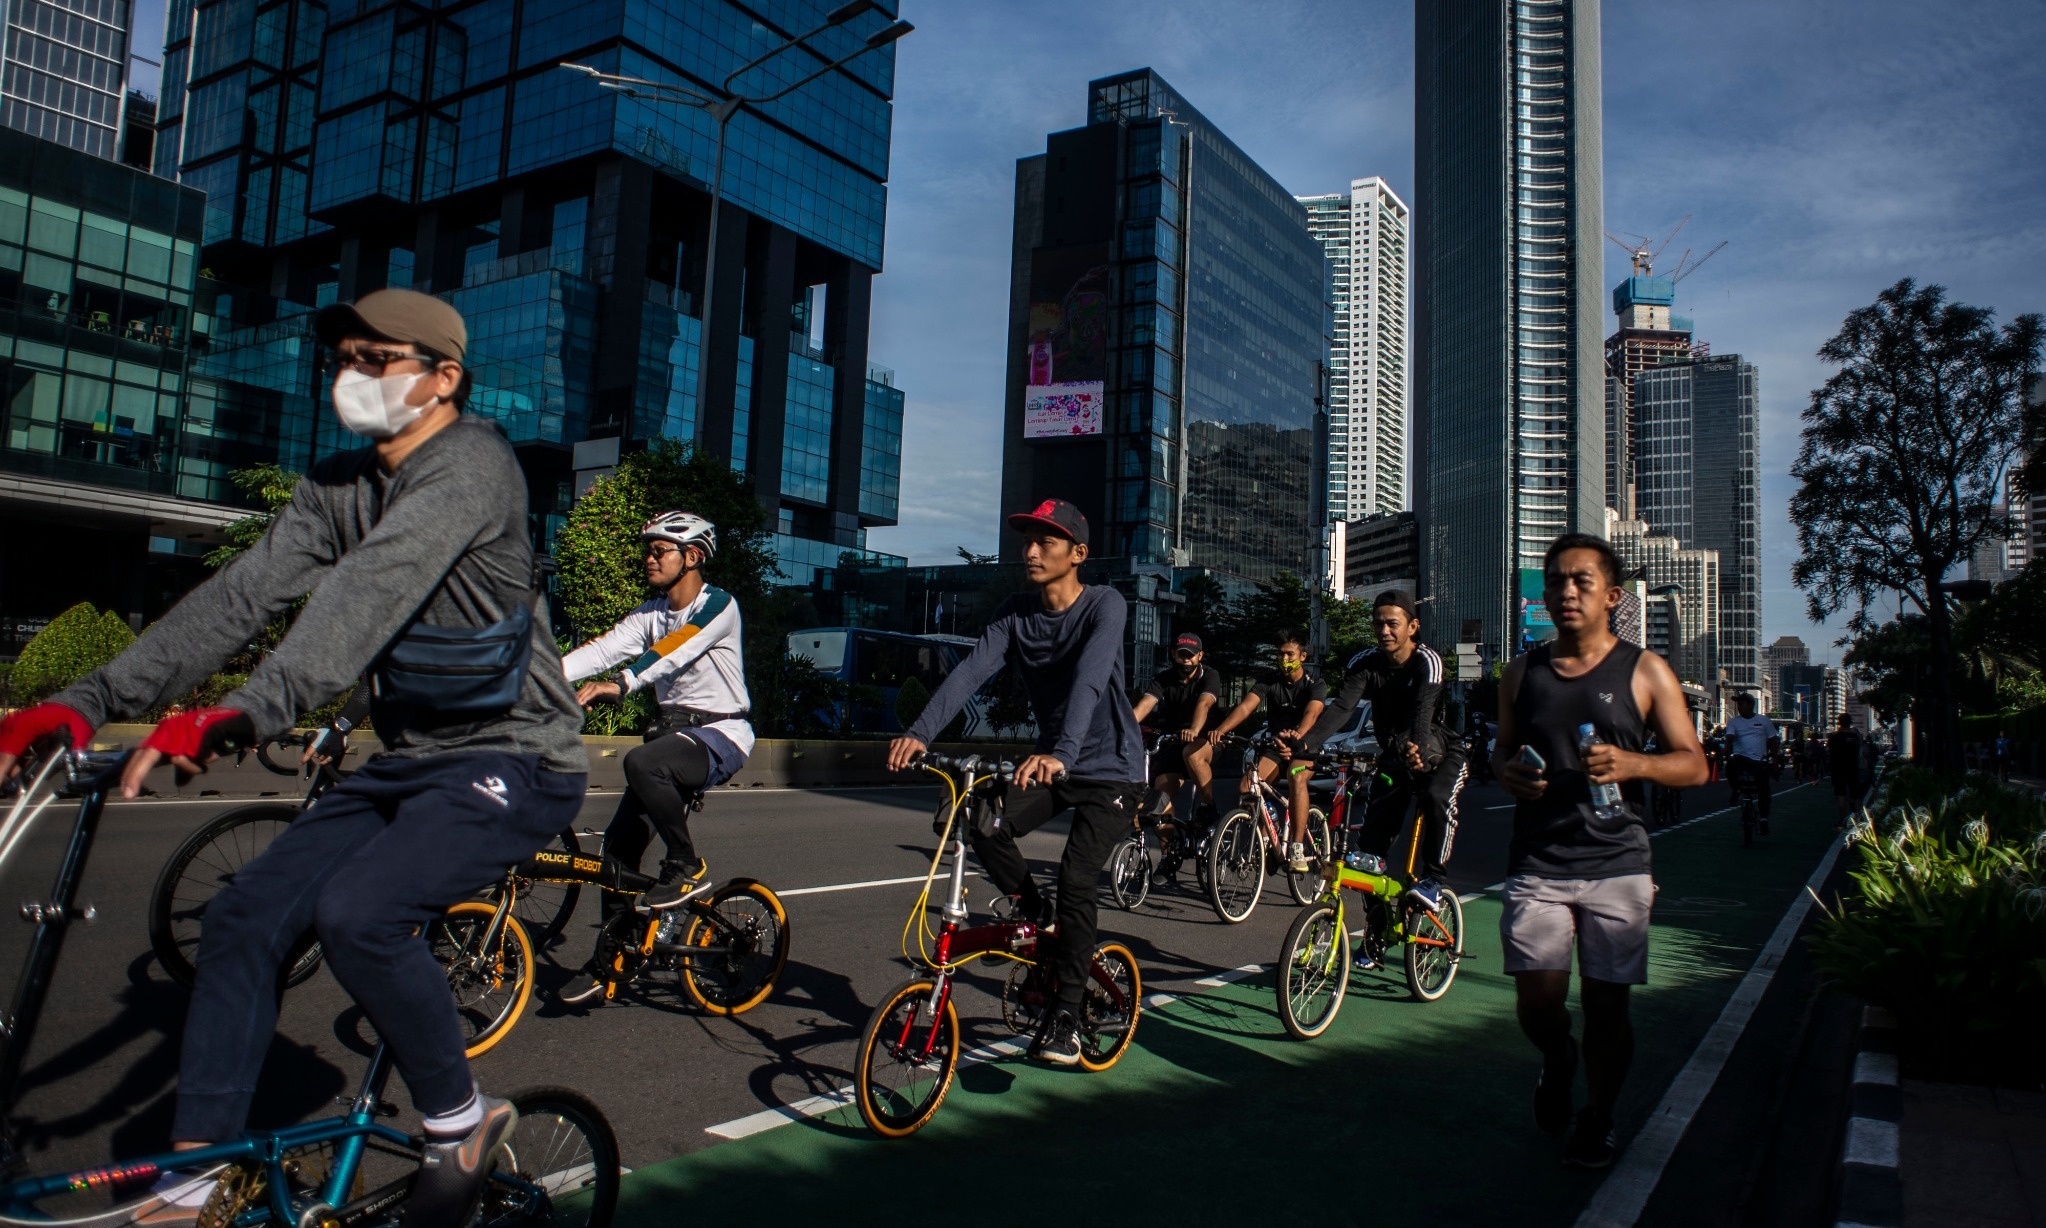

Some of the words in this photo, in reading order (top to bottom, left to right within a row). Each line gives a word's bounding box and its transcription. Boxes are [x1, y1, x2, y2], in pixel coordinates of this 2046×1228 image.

[17, 624, 47, 632] CHUB
[535, 852, 570, 864] POLICE
[573, 857, 602, 873] BROBOT
